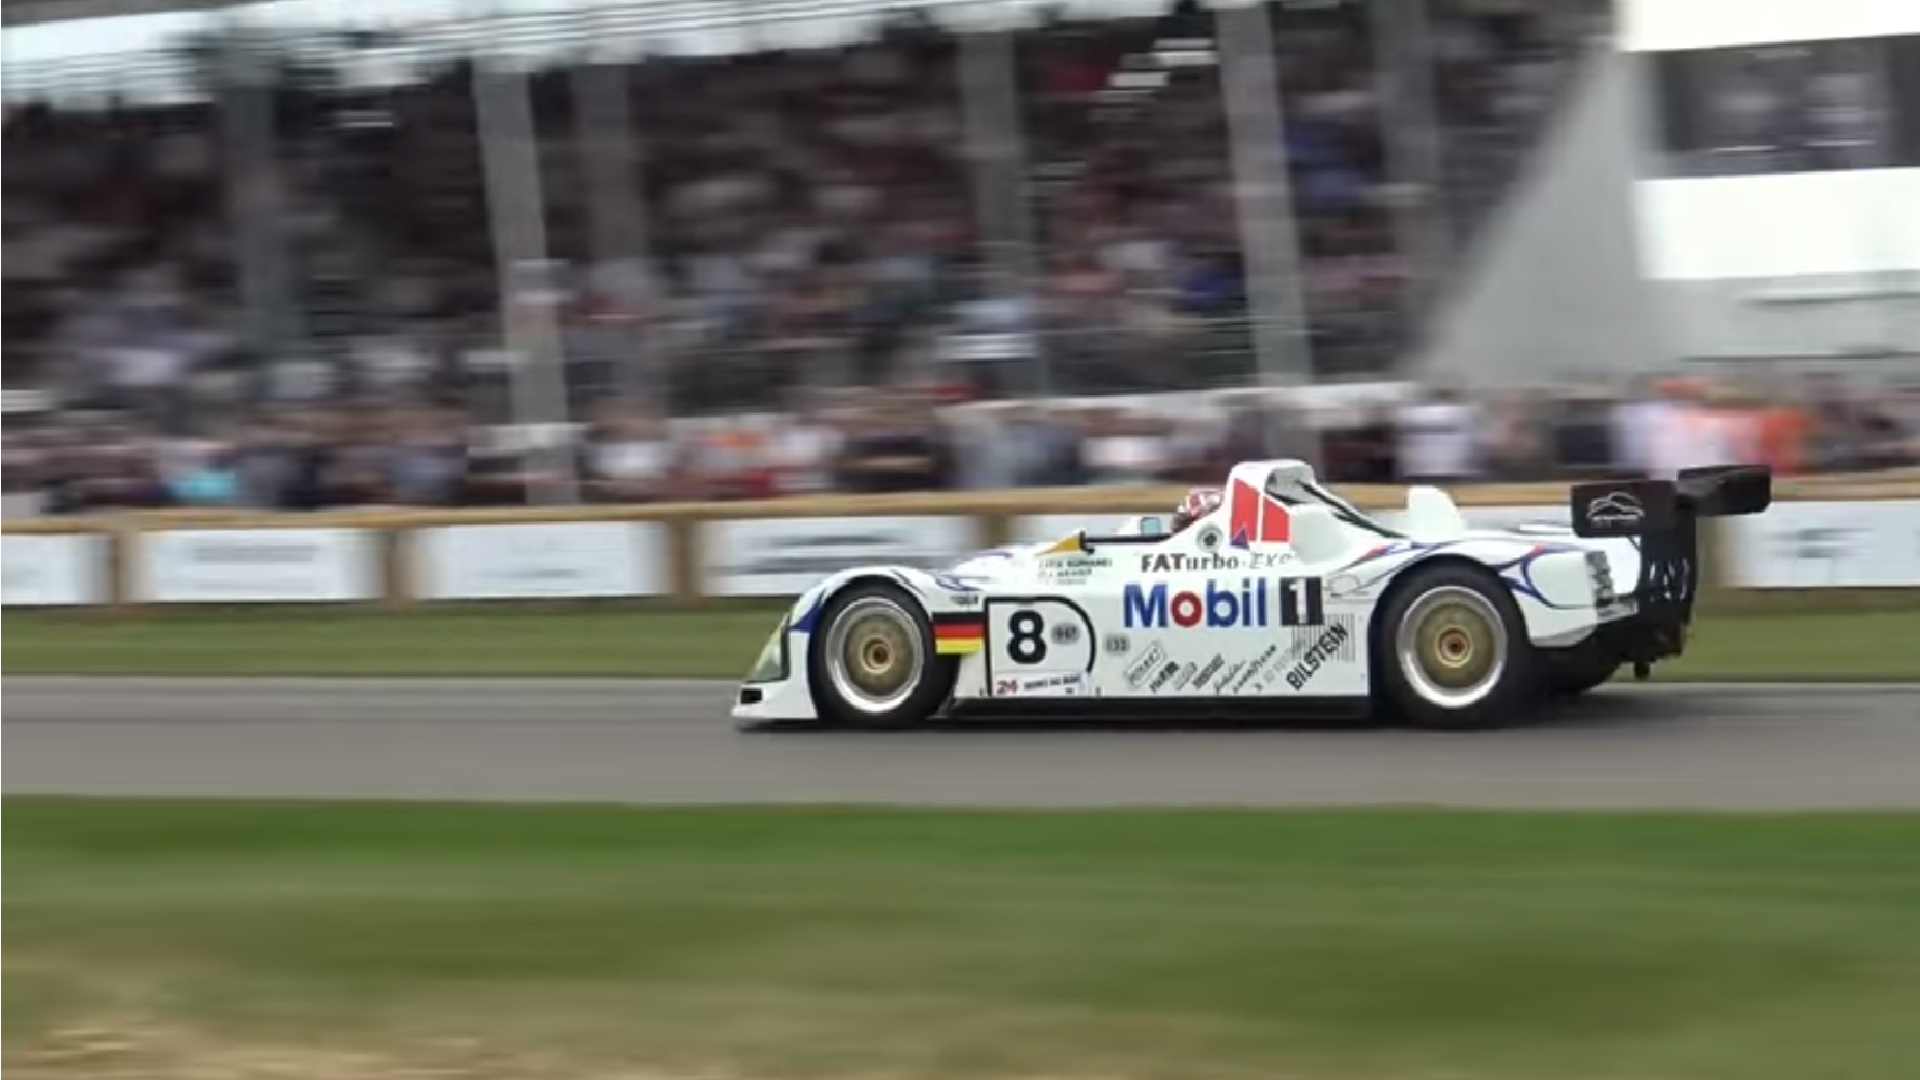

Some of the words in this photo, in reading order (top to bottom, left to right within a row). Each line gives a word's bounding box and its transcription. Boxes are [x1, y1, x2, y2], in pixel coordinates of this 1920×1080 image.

[1124, 577, 1267, 628] Mobil
[1007, 609, 1047, 665] 8
[1286, 622, 1348, 690] BILSTEIN
